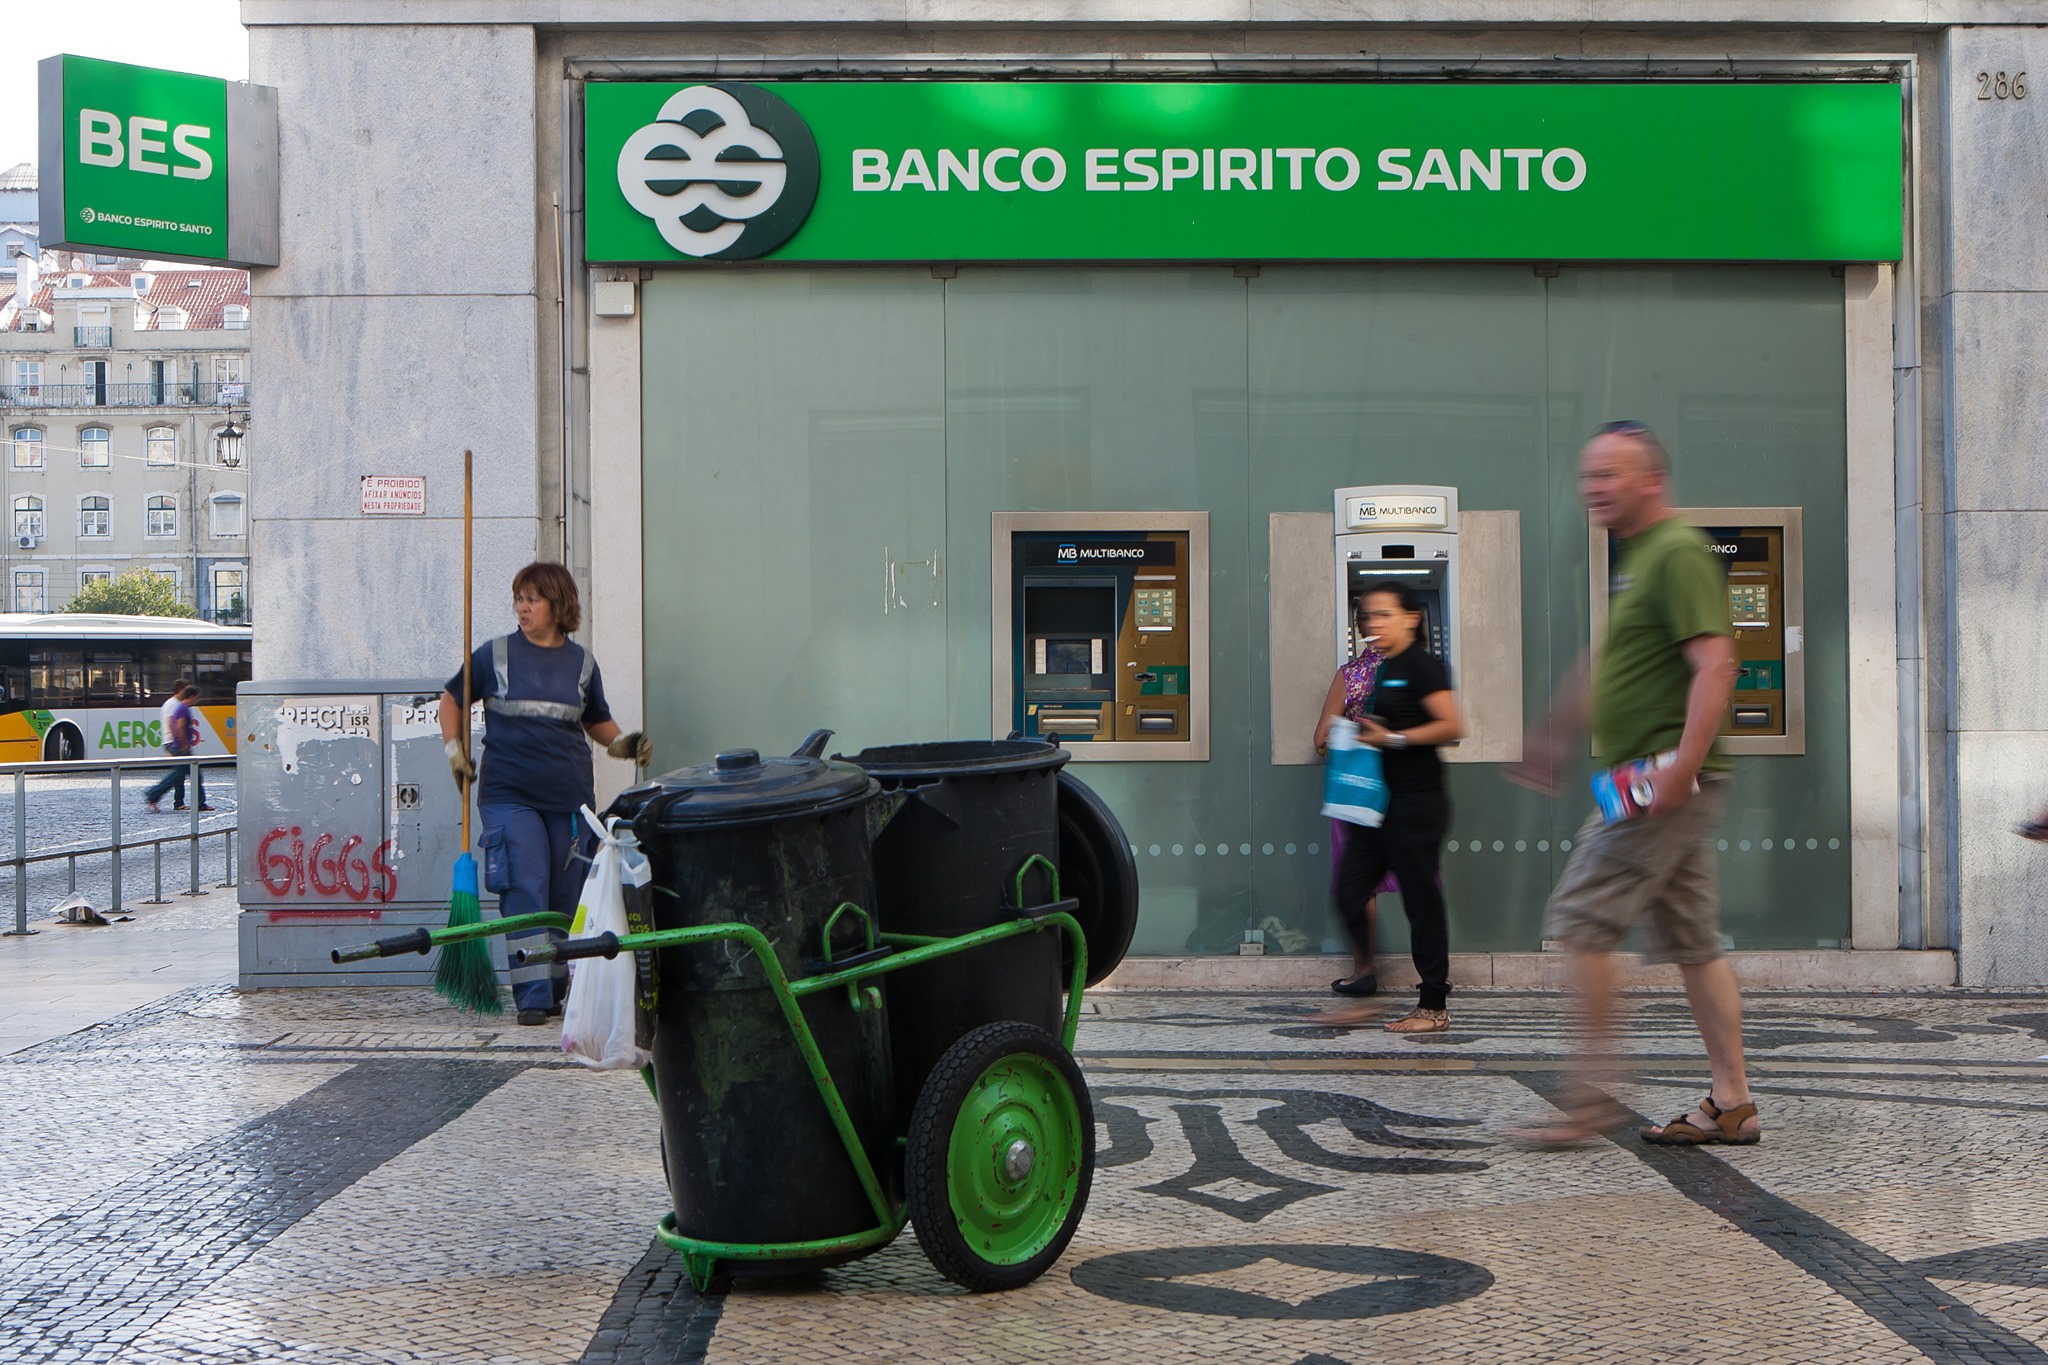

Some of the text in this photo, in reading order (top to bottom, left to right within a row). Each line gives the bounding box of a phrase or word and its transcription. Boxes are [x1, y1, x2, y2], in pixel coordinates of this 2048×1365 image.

[1977, 71, 2026, 100] 286
[79, 108, 213, 181] BES
[852, 147, 1587, 192] BANCO ESPIRITO SANTO
[97, 212, 213, 235] BANCO ESPIRITO SANTO
[377, 479, 420, 488] PROIBIDO
[364, 490, 387, 499] AFIXAR
[363, 501, 422, 511] NESTA PROPRIEDADE
[1359, 506, 1437, 516] MB MULTIBANCO
[1057, 548, 1145, 559] MB MULTIBANCO
[351, 716, 370, 726] ISR
[98, 719, 200, 750] AEROS
